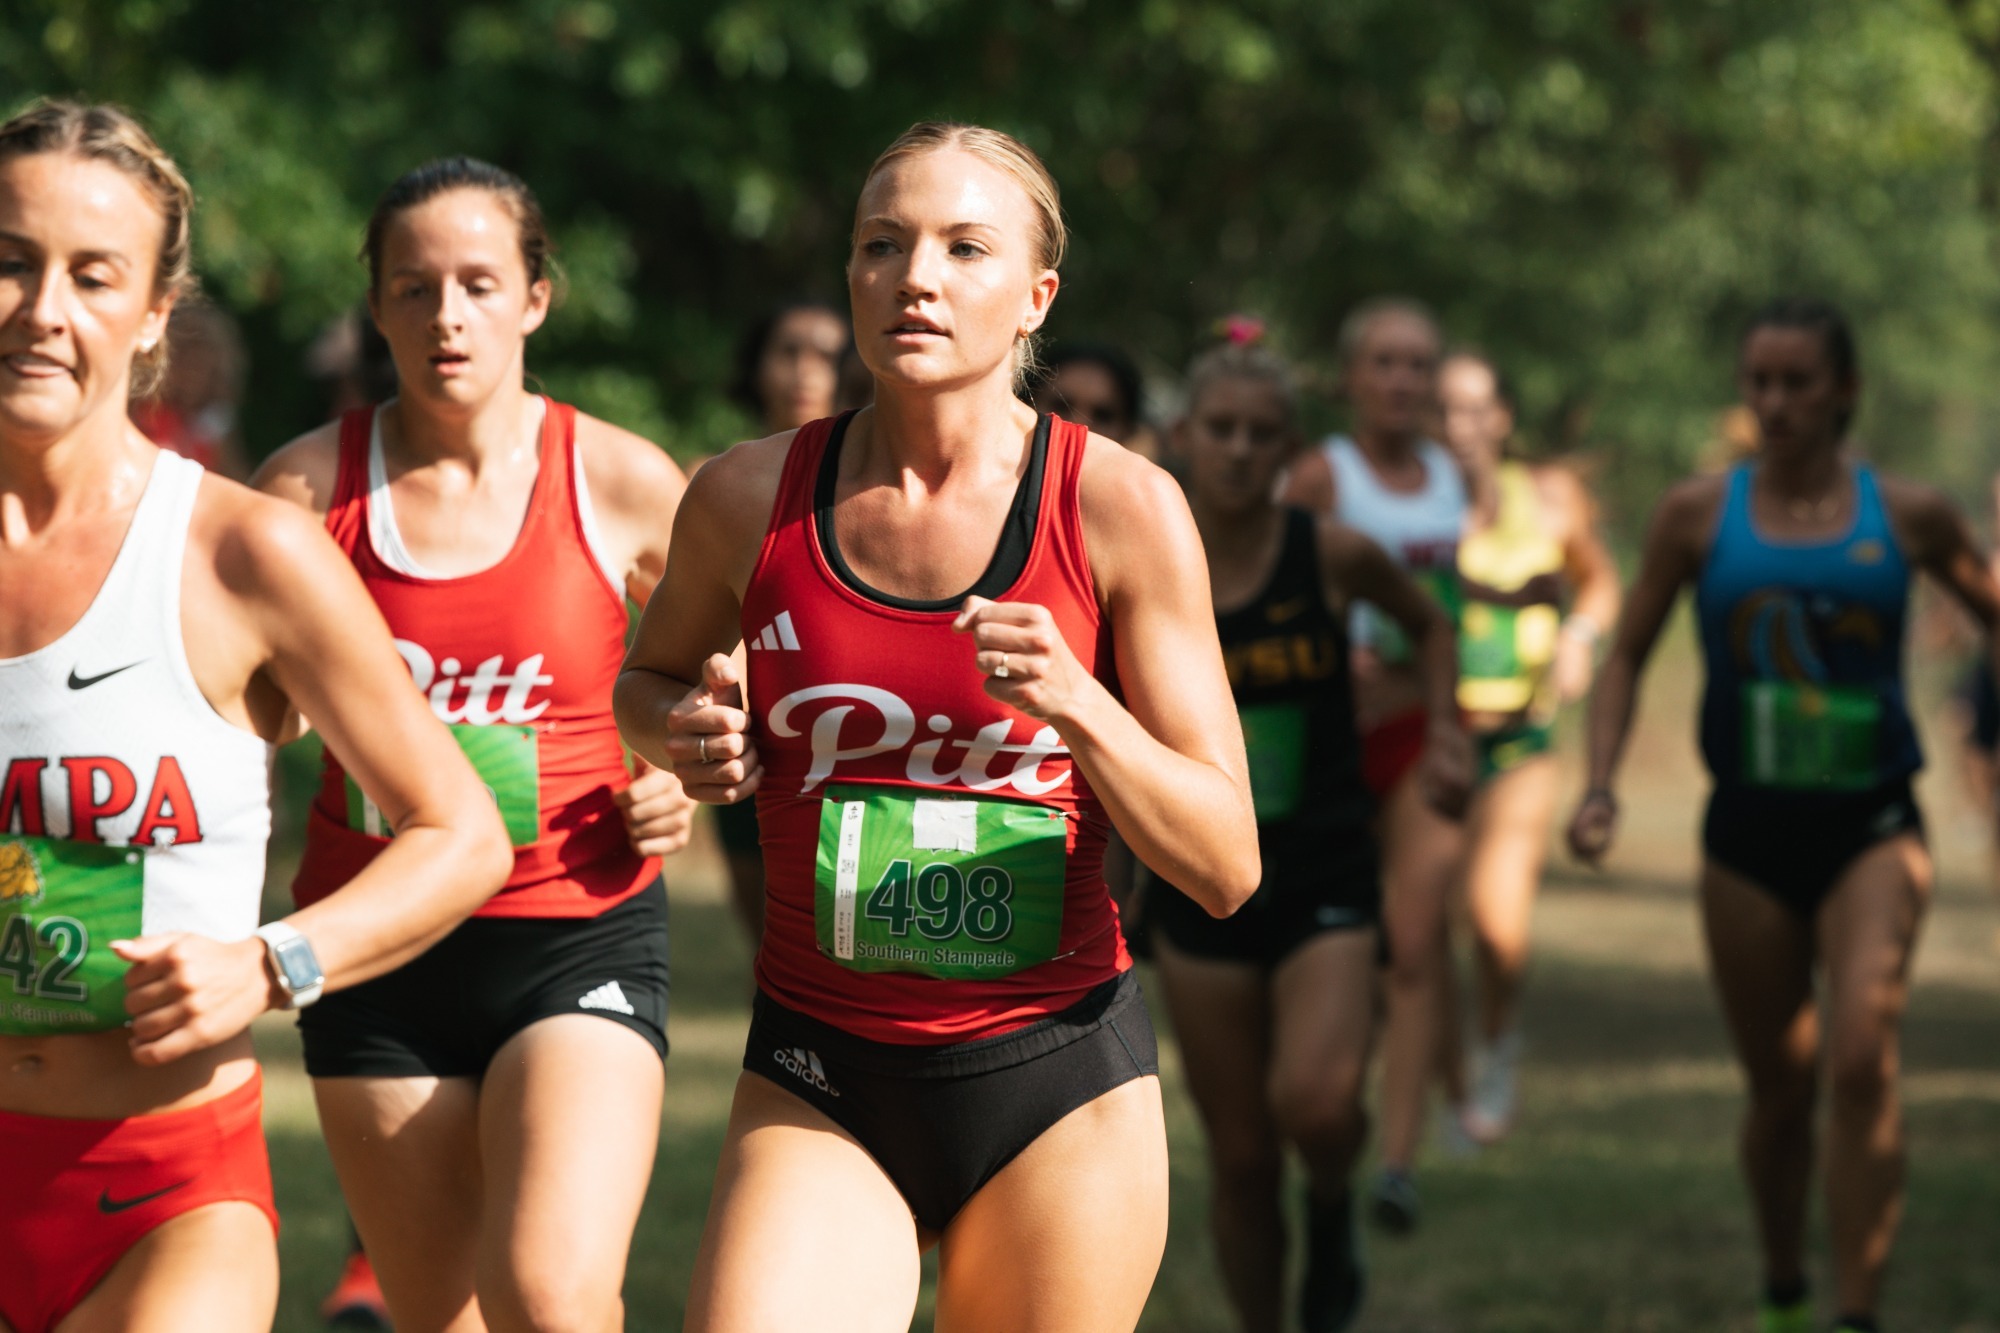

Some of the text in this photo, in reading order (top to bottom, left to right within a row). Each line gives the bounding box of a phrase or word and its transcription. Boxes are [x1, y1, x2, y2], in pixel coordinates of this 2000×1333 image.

[768, 683, 1072, 794] Pitt
[865, 859, 1013, 941] 498
[856, 940, 1016, 969] Southern Stampede
[773, 1049, 840, 1097] adidas
